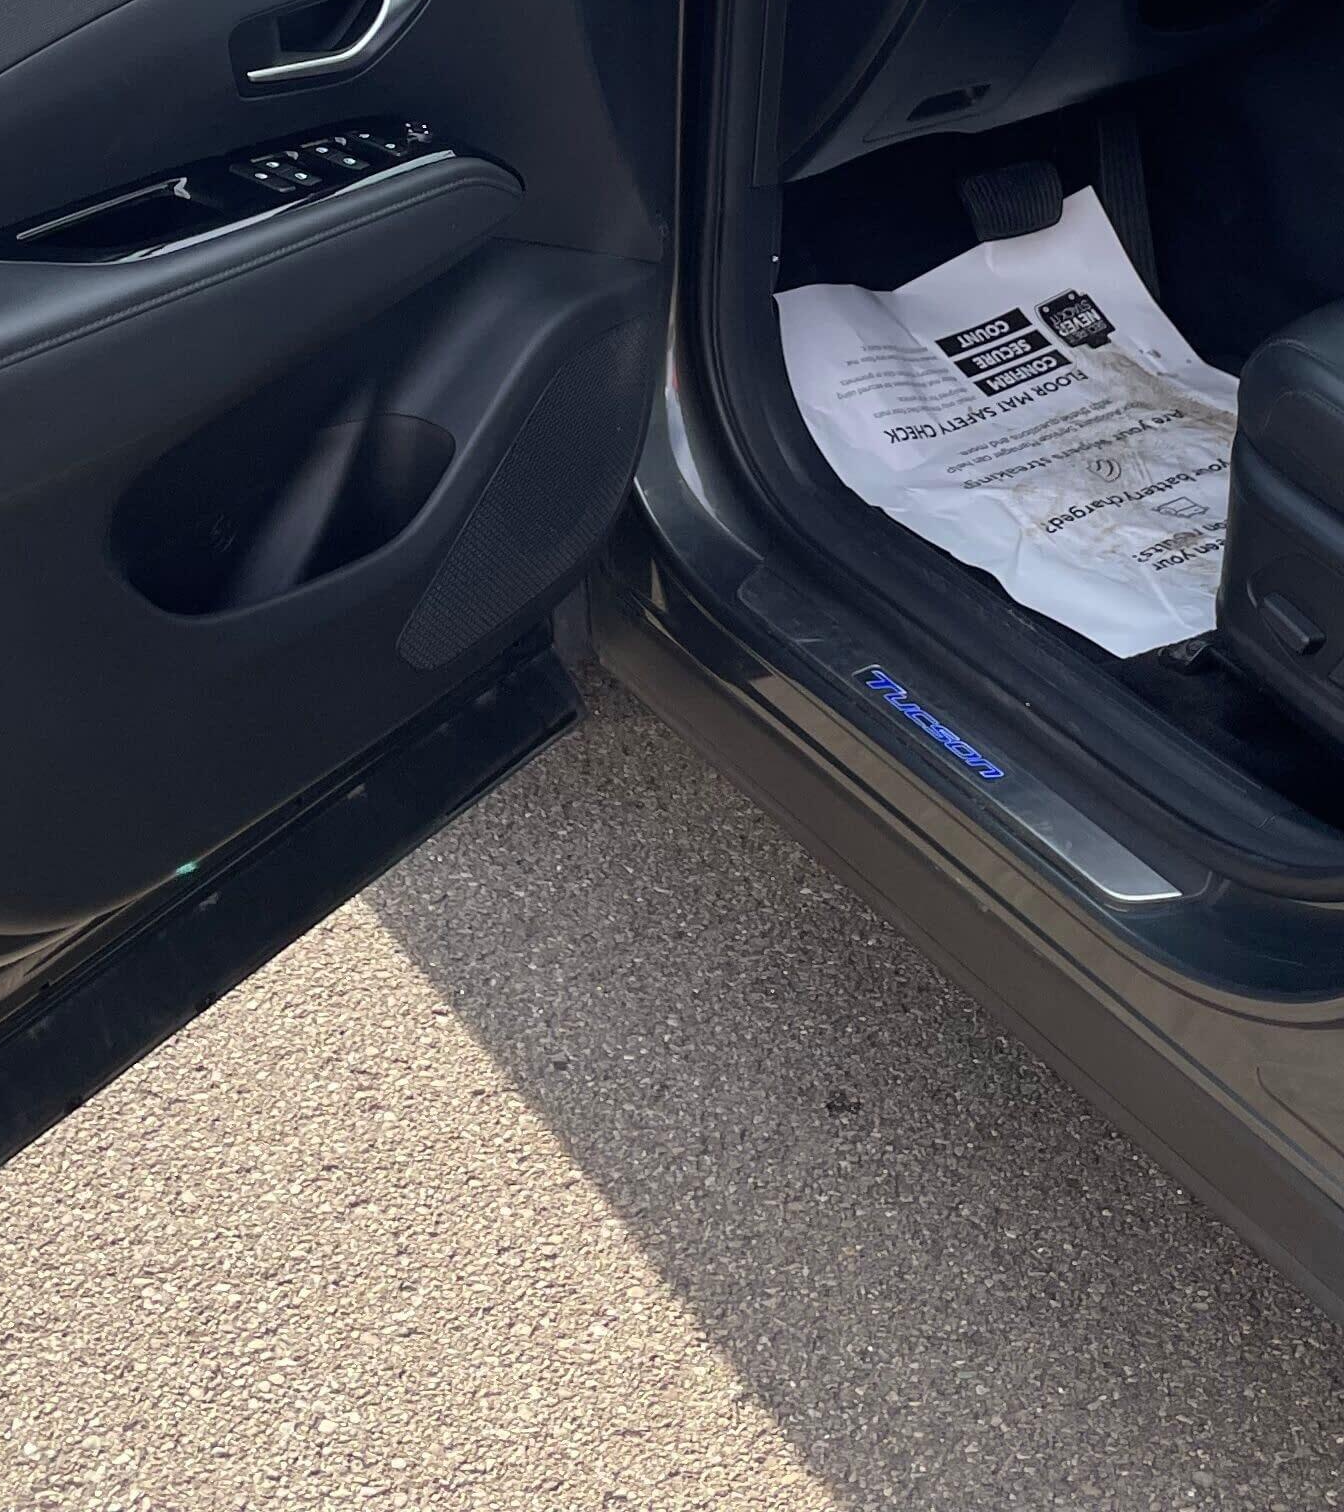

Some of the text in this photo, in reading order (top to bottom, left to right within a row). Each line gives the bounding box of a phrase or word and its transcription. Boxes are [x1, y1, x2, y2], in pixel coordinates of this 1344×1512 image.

[955, 319, 1009, 347] COUNT
[1055, 308, 1100, 336] NEVER
[971, 338, 1031, 369] SECURE
[985, 354, 1057, 389] CONFIRM
[1030, 368, 1088, 398] FLOOR
[996, 391, 1032, 413] MAT
[938, 405, 996, 434] SAFETY
[1112, 419, 1150, 441] your
[1152, 409, 1182, 424] Are
[883, 424, 936, 443] CHECK
[1123, 471, 1196, 505] battery
[1040, 496, 1122, 534] charged?
[1152, 547, 1195, 572] your
